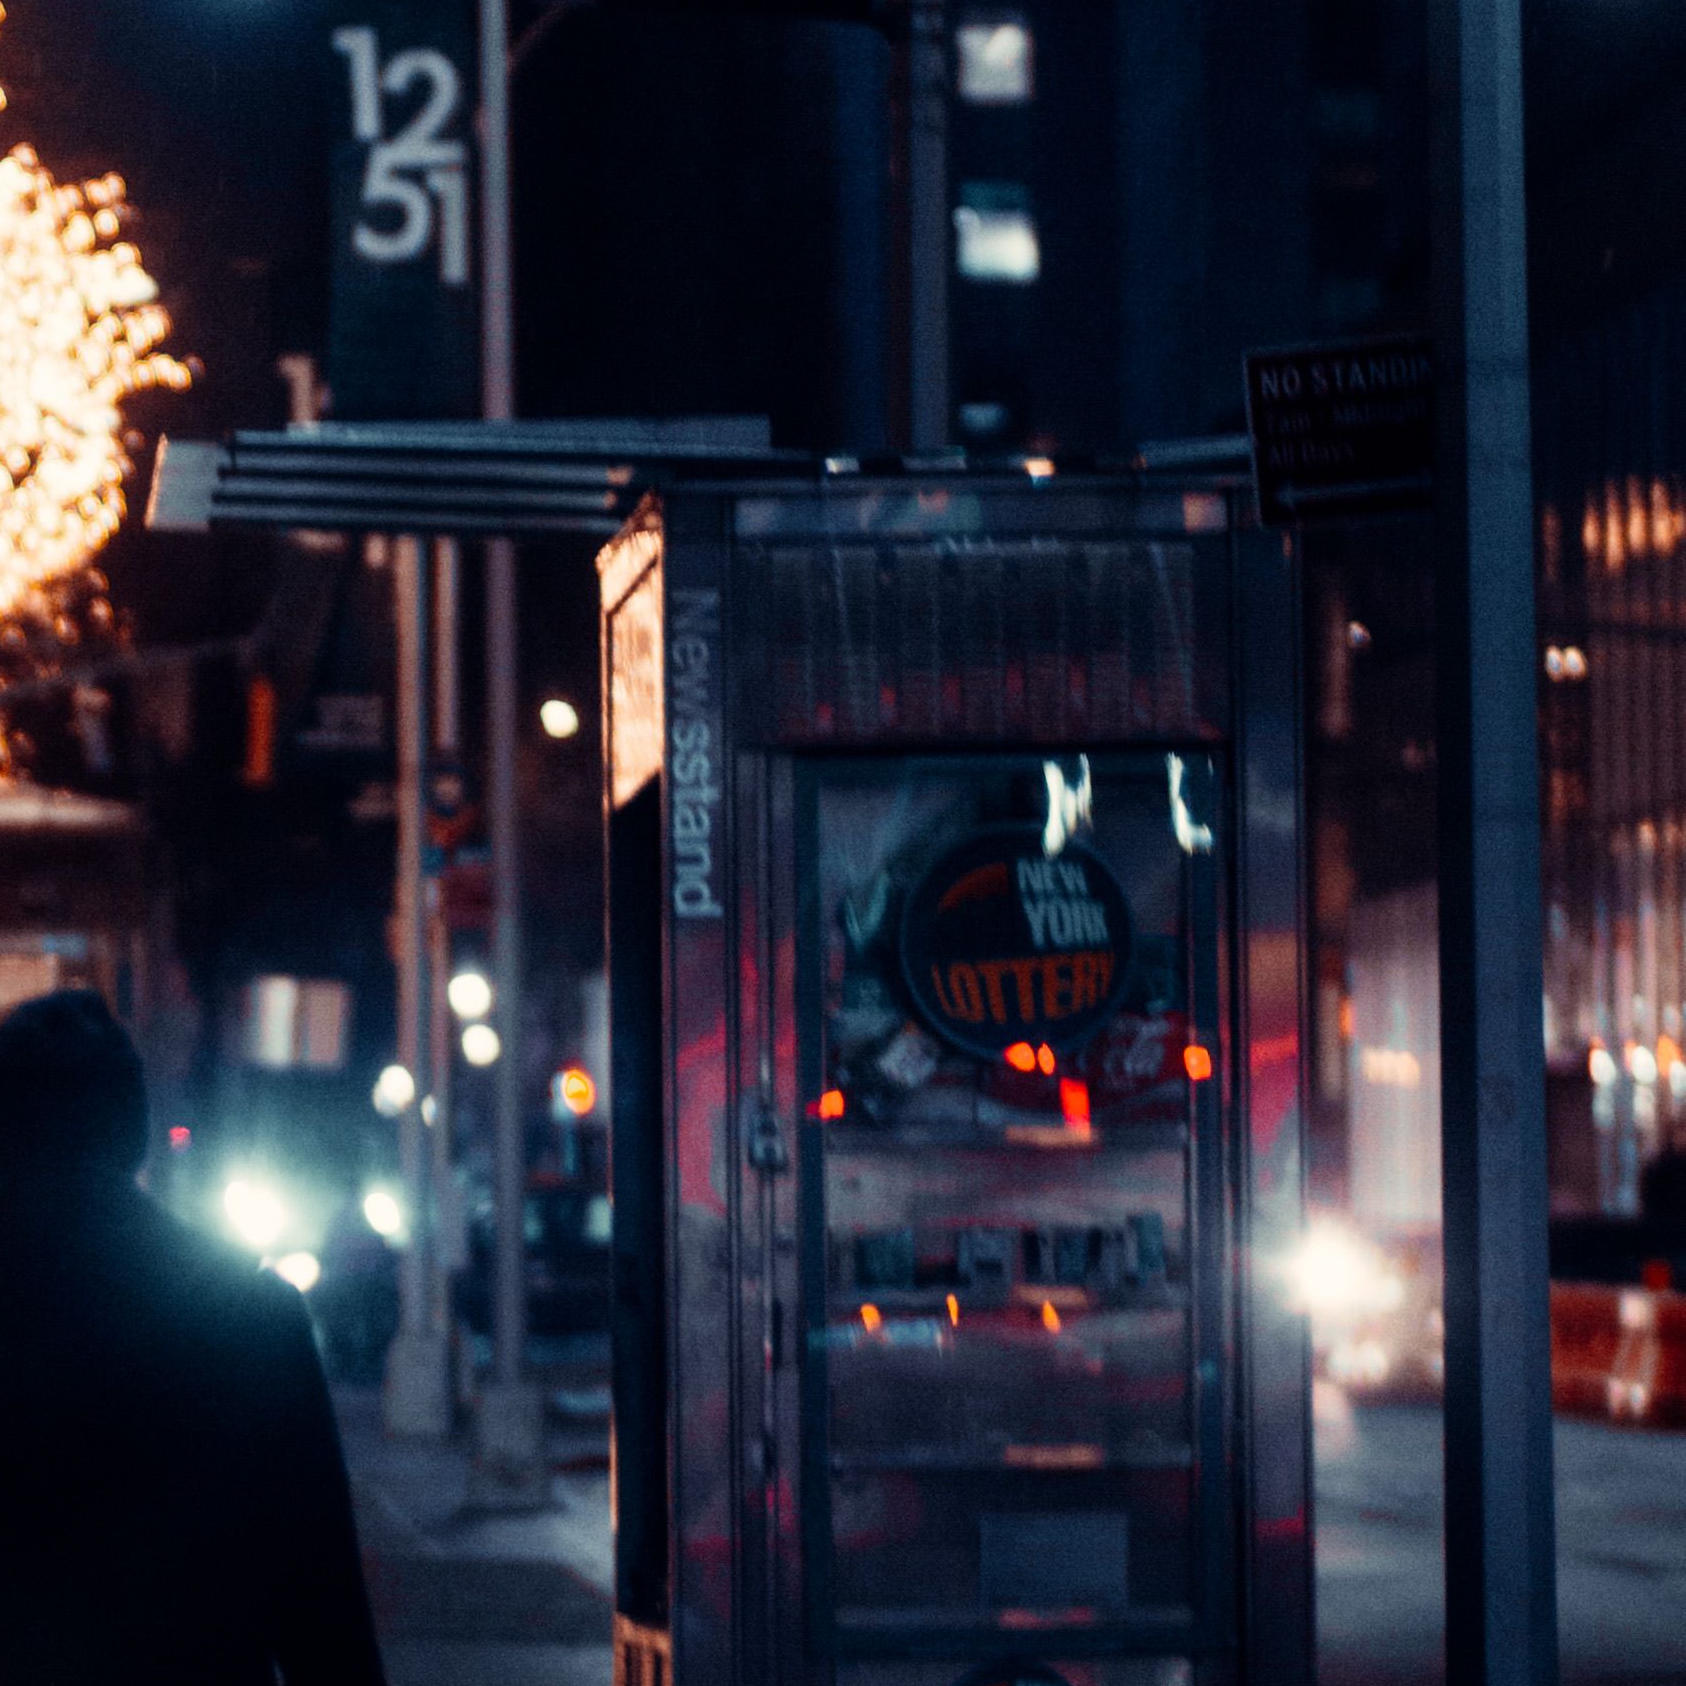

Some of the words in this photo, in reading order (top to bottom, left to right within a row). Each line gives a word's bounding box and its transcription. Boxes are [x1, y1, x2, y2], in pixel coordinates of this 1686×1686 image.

[1258, 362, 1302, 401] NO
[671, 589, 725, 919] Newsstand
[1016, 858, 1089, 897] NEW
[1020, 897, 1110, 949] YORK
